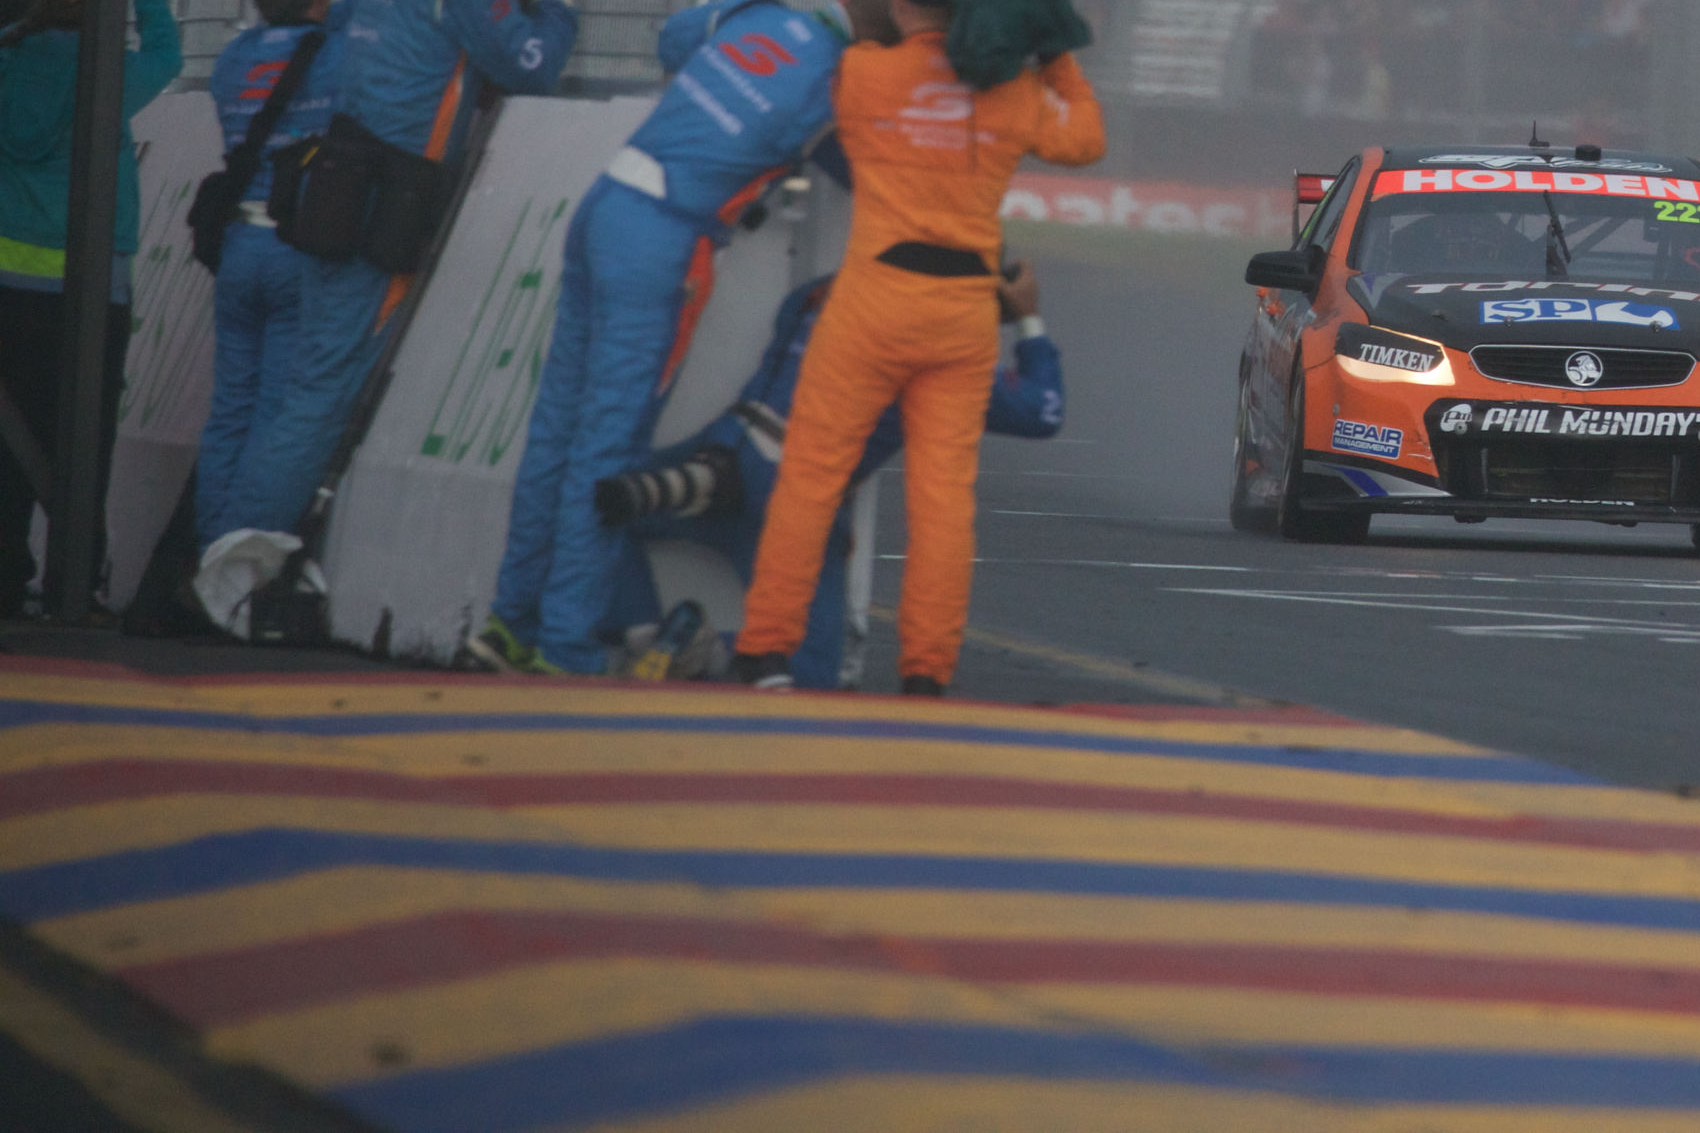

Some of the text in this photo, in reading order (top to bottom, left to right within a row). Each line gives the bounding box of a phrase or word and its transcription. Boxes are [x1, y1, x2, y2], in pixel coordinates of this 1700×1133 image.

[1402, 170, 1700, 201] HOLDEN
[1359, 344, 1435, 371] TIMKEN
[1334, 420, 1402, 444] REPAIR
[1481, 407, 1551, 433] PHIL
[1334, 437, 1395, 454] MANAGEMENT
